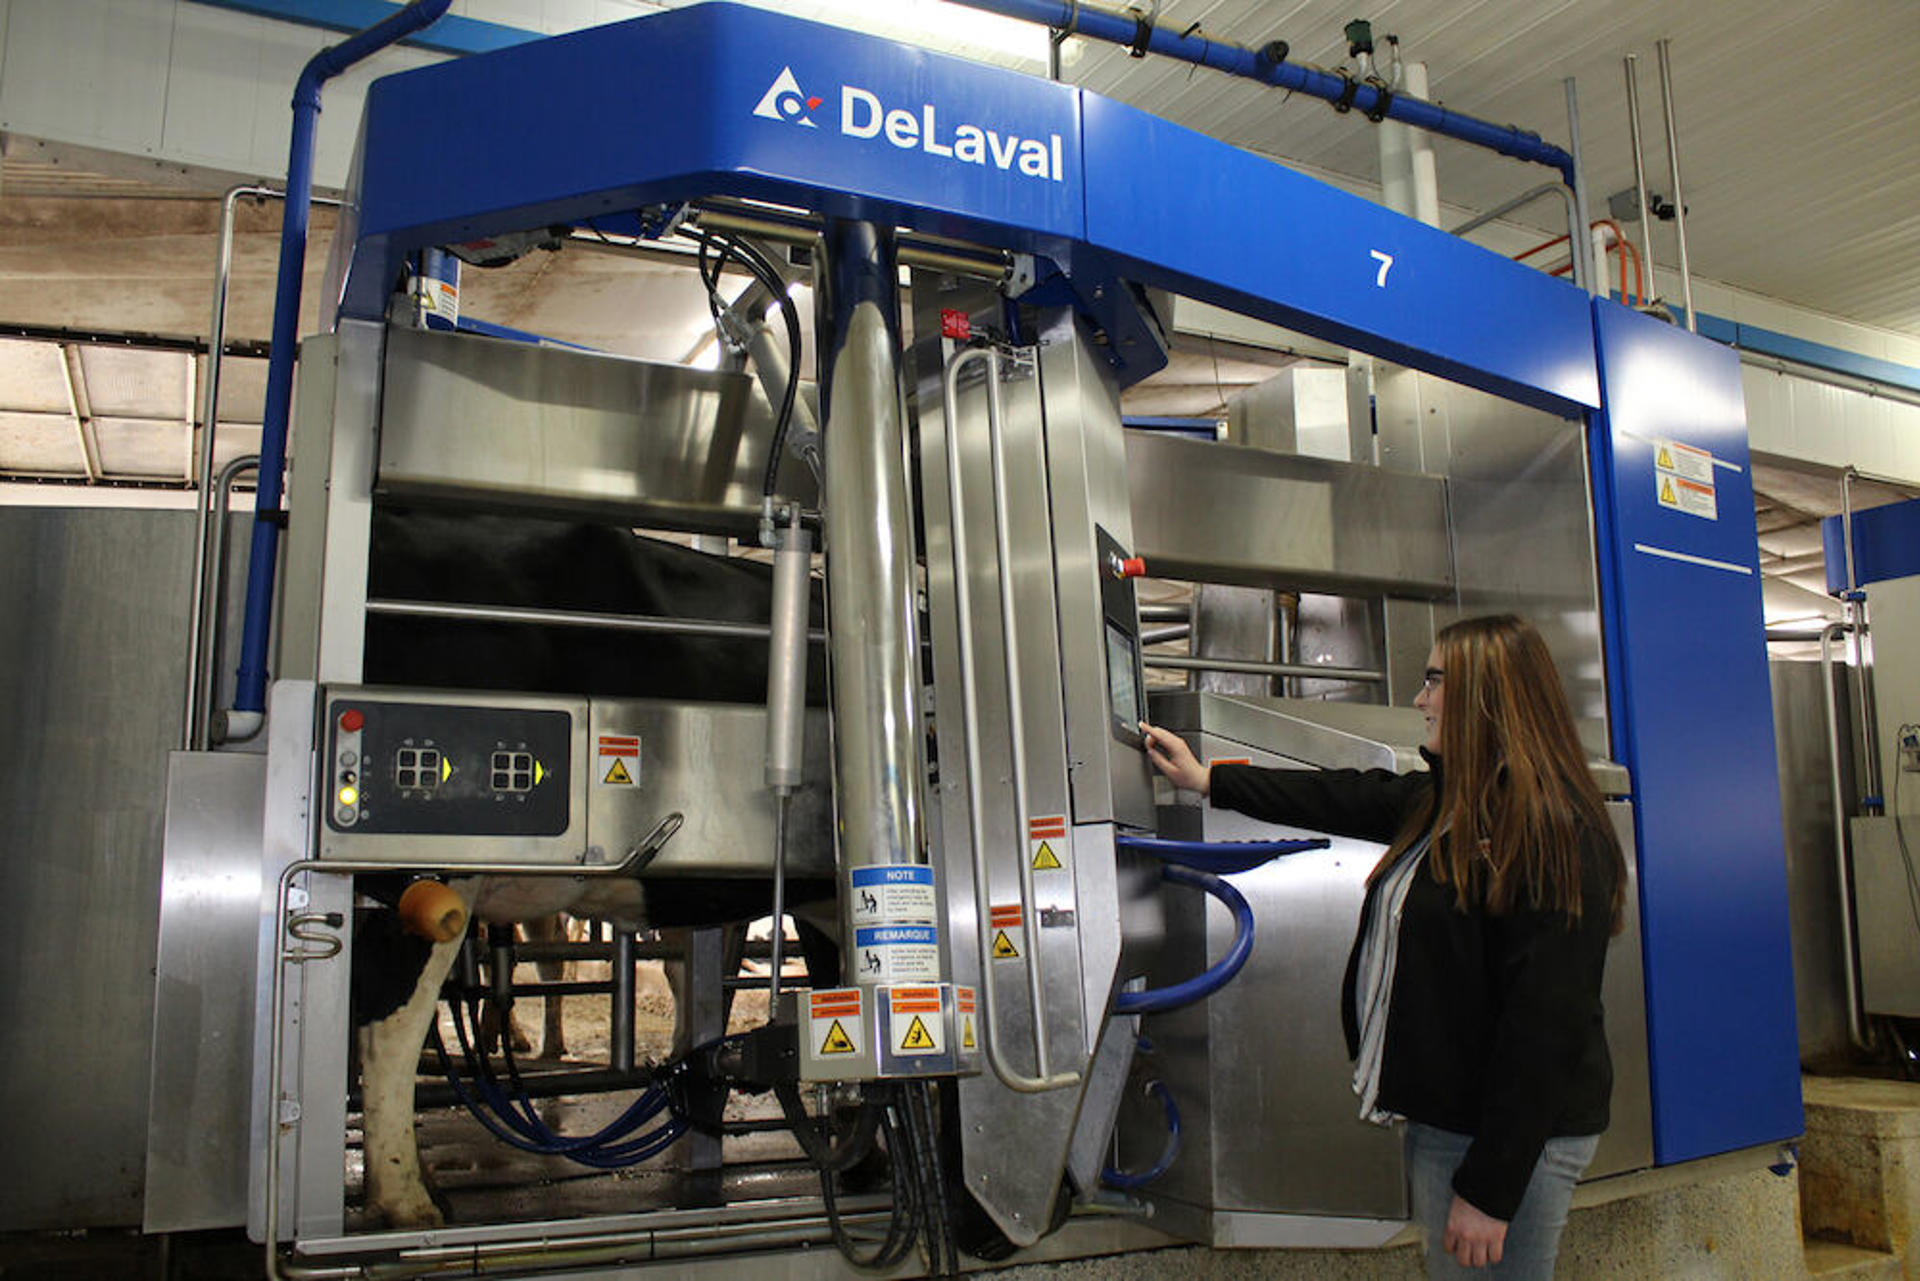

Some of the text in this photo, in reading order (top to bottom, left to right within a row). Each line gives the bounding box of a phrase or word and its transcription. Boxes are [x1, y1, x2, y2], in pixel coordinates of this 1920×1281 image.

[841, 85, 1063, 182] DeLaval
[1371, 249, 1393, 287] 7
[886, 870, 915, 881] NOTE
